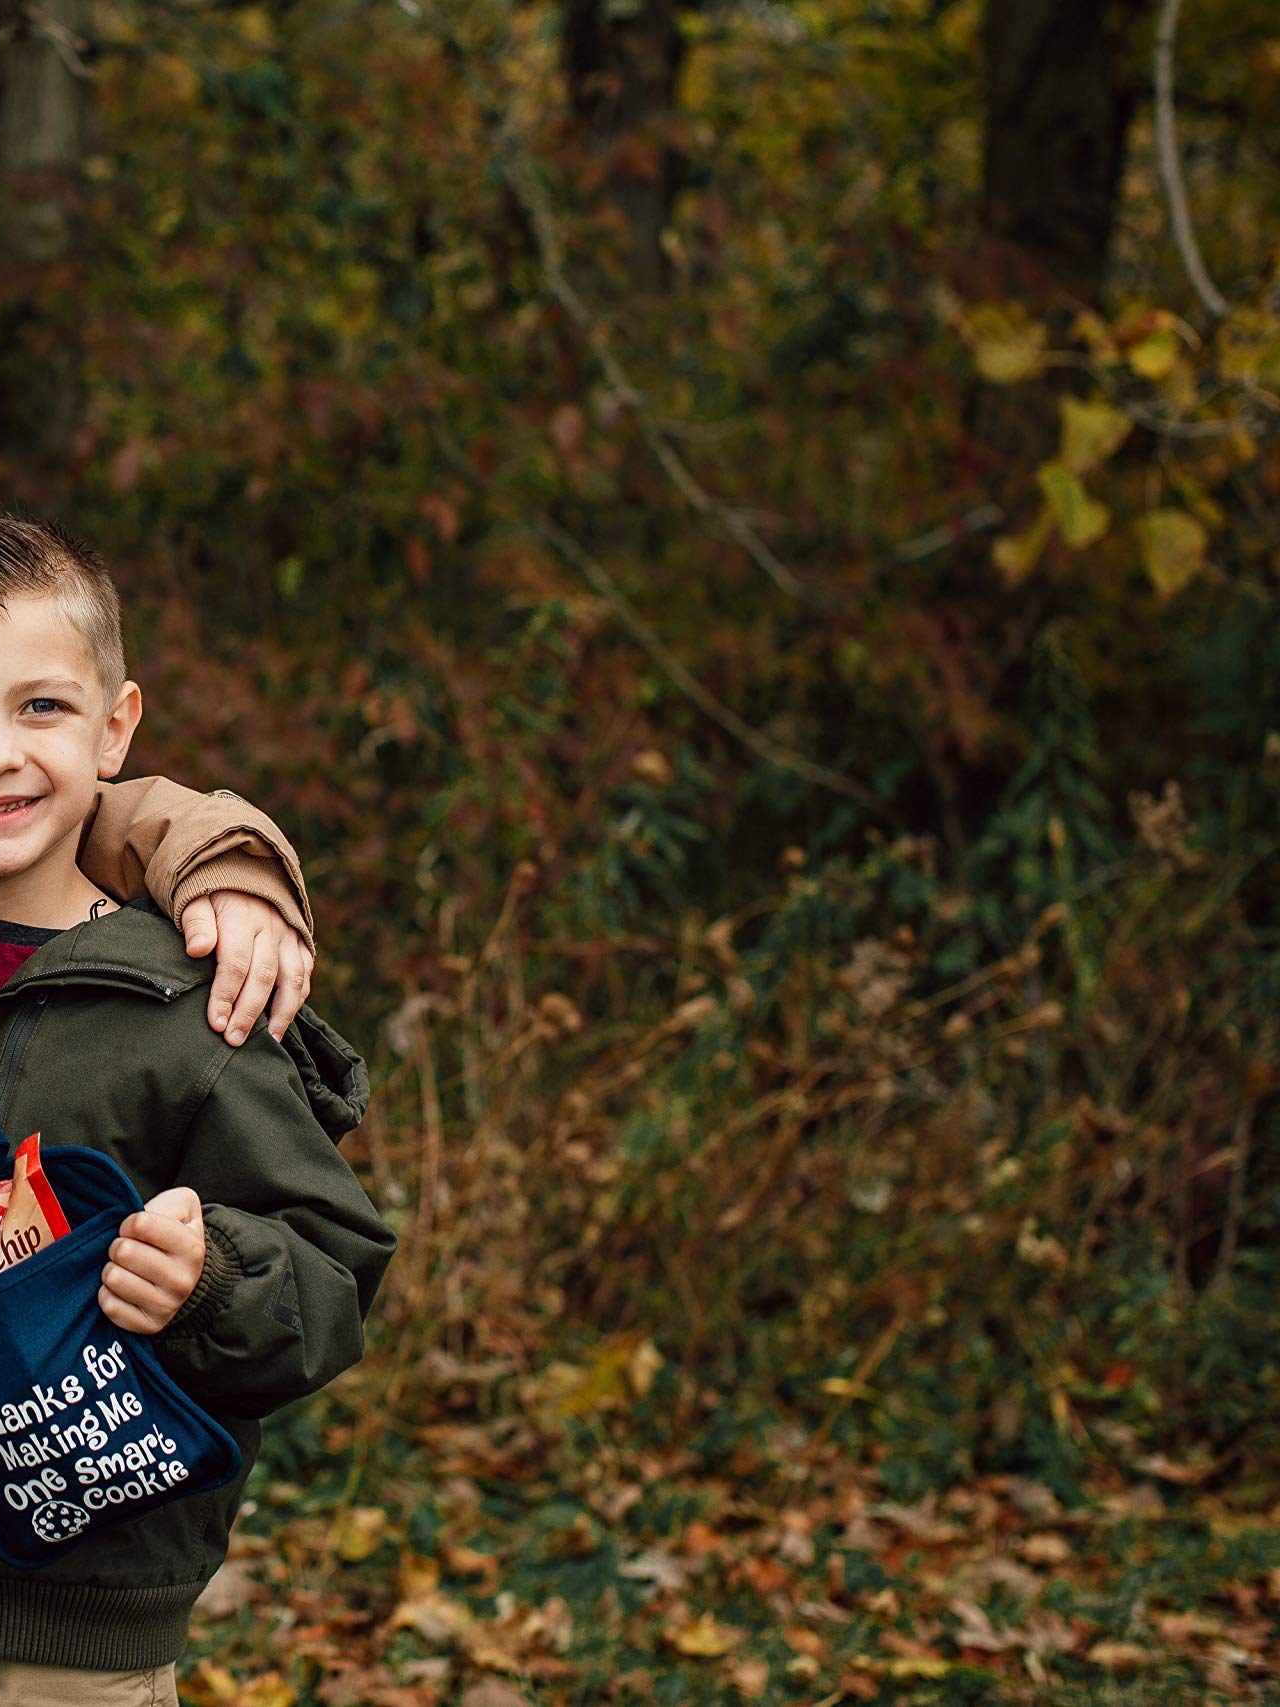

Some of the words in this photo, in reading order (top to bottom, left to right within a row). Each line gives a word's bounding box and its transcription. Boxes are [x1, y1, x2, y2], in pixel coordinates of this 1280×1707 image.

[82, 1340, 126, 1390] for
[96, 1391, 142, 1432] Me
[3, 1468, 67, 1510] One
[75, 1424, 177, 1485] Smart
[83, 1460, 189, 1510] Cookie
